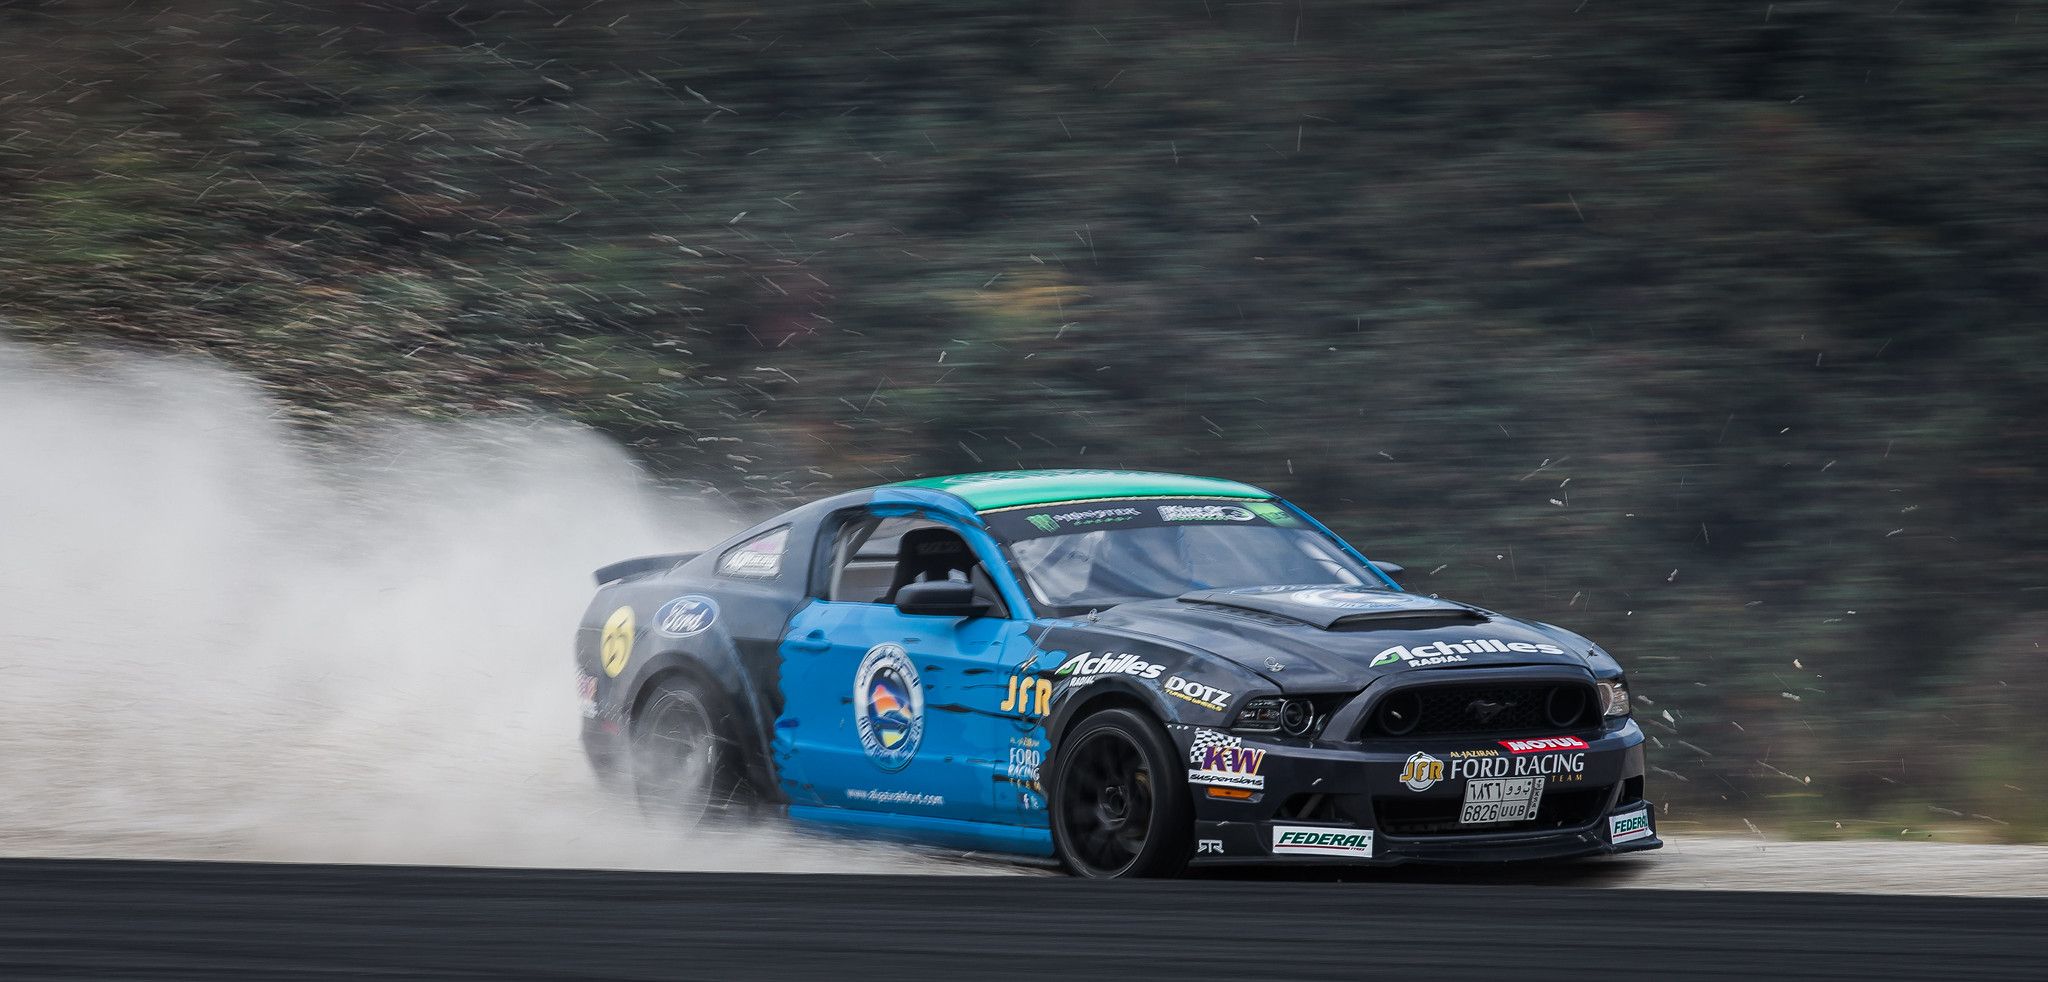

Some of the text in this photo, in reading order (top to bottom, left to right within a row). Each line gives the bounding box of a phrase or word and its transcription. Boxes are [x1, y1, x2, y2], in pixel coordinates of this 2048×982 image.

[661, 600, 709, 632] Ford
[1369, 639, 1565, 668] Achilles
[1408, 655, 1468, 668] RADIAL
[1054, 651, 1166, 679] Achilles
[1069, 675, 1096, 688] RADIAL
[1164, 675, 1232, 708] DOTZ
[1000, 675, 1053, 717] JFR
[1450, 749, 1499, 759] AL-JAZIRAH
[1508, 737, 1583, 751] MOTUL
[1009, 747, 1040, 768] FORD
[1201, 746, 1267, 776] KW
[1450, 752, 1585, 780] FORD RACING
[1008, 764, 1040, 781] RACING
[1189, 773, 1263, 786] suspensions
[1399, 760, 1444, 782] JFR
[1551, 774, 1583, 783] TEAM
[1463, 803, 1526, 822] 6826 UUB
[1278, 831, 1368, 848] FEDERAL
